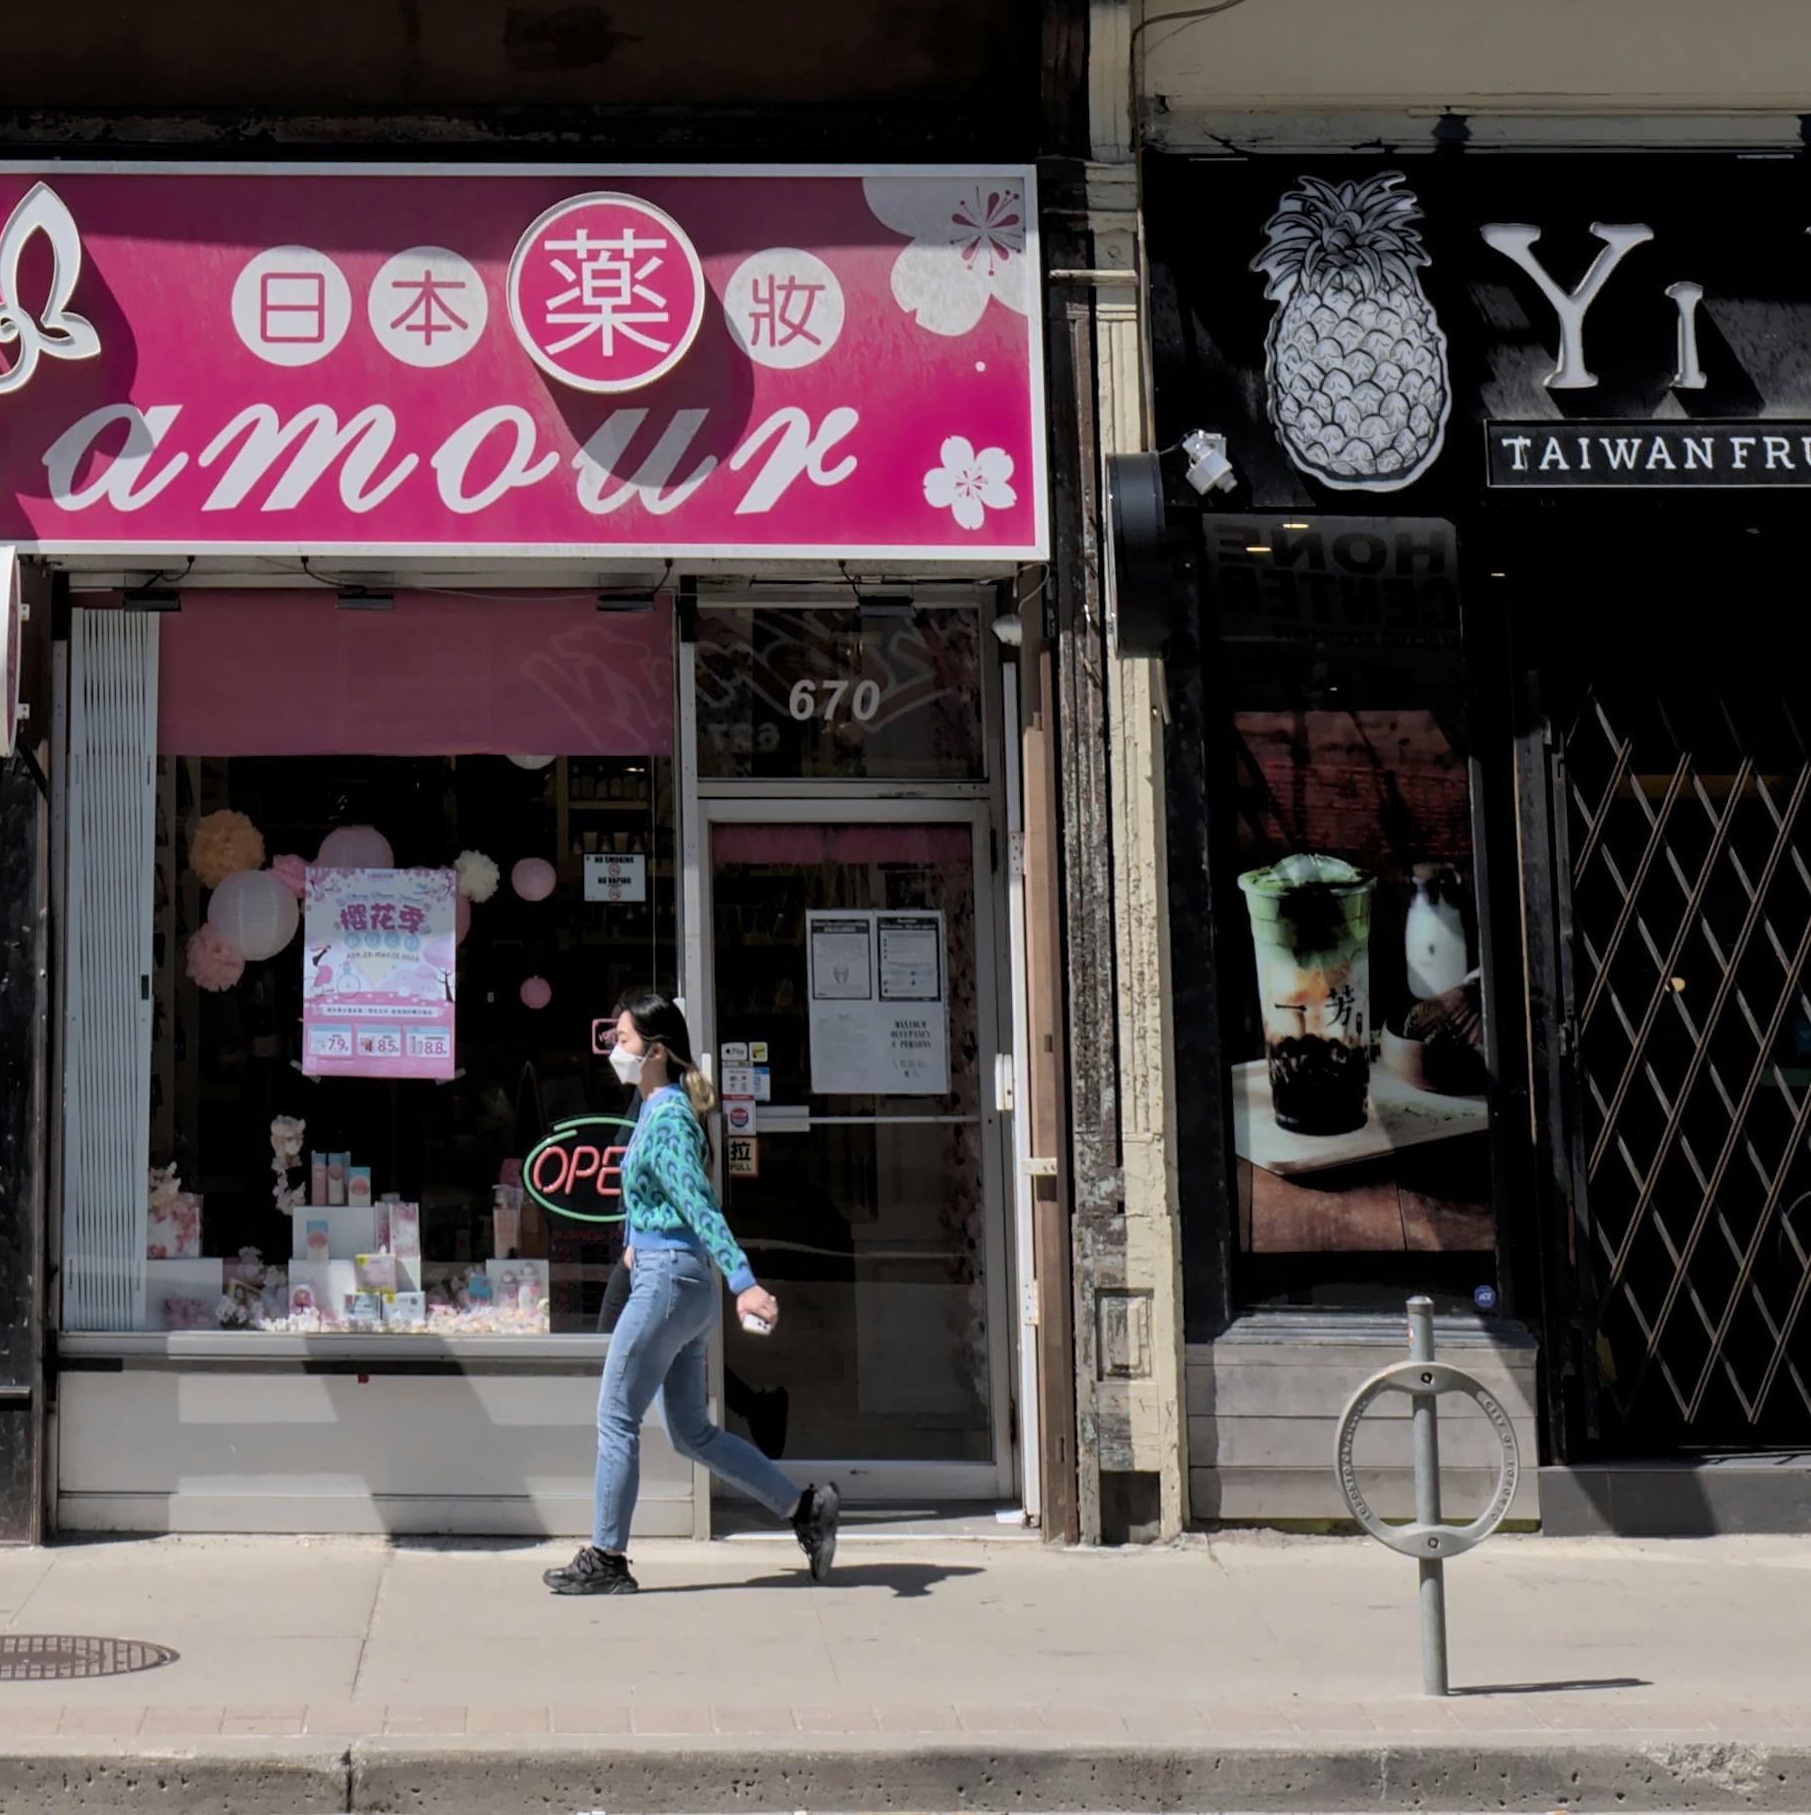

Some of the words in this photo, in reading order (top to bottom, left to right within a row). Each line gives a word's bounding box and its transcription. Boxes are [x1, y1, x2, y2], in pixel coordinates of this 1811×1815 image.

[1502, 436, 1714, 470] TAIWAN
[789, 679, 880, 721] 670
[1274, 984, 1356, 1027] 一芳
[730, 1162, 752, 1172] PULL
[731, 1140, 751, 1162] 拉
[533, 1146, 625, 1196] OPE
